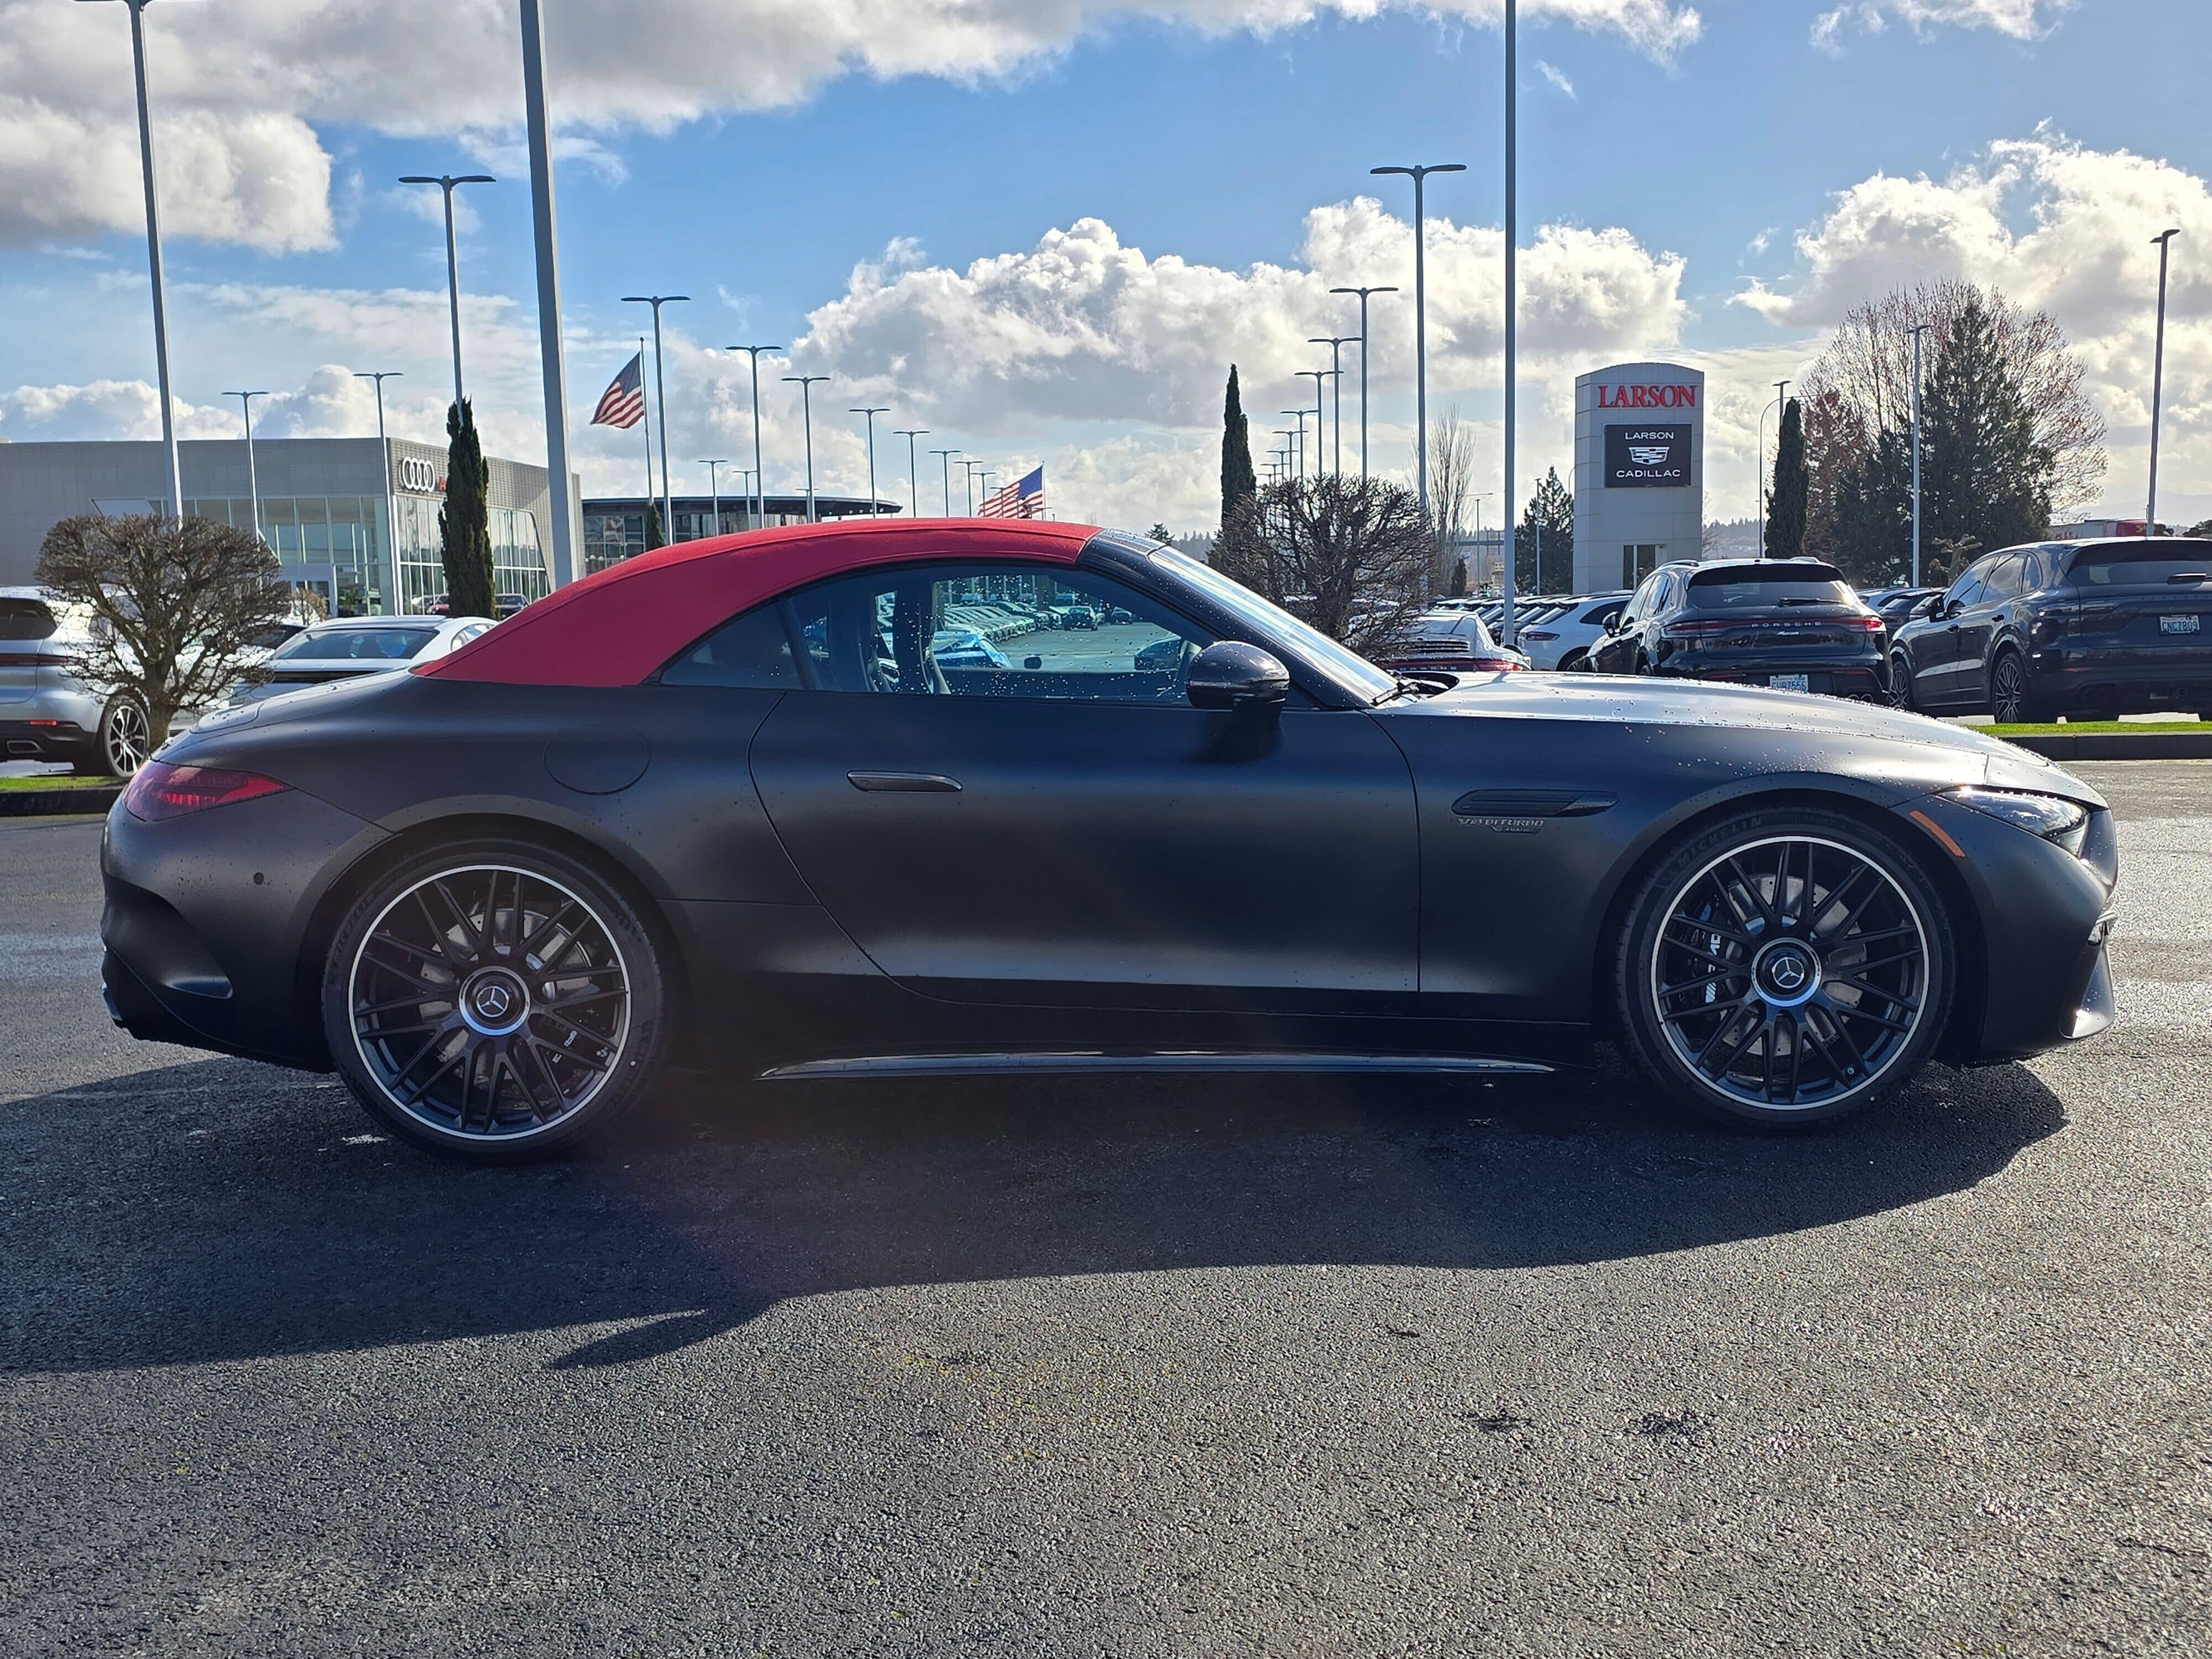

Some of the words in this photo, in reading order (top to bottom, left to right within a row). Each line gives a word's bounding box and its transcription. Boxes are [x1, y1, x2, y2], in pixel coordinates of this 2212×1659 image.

[1598, 385, 1697, 408] LARSON
[1625, 431, 1674, 440] LARSON
[1616, 469, 1681, 478] CADILLAC
[1676, 817, 1762, 868] MICHELIN
